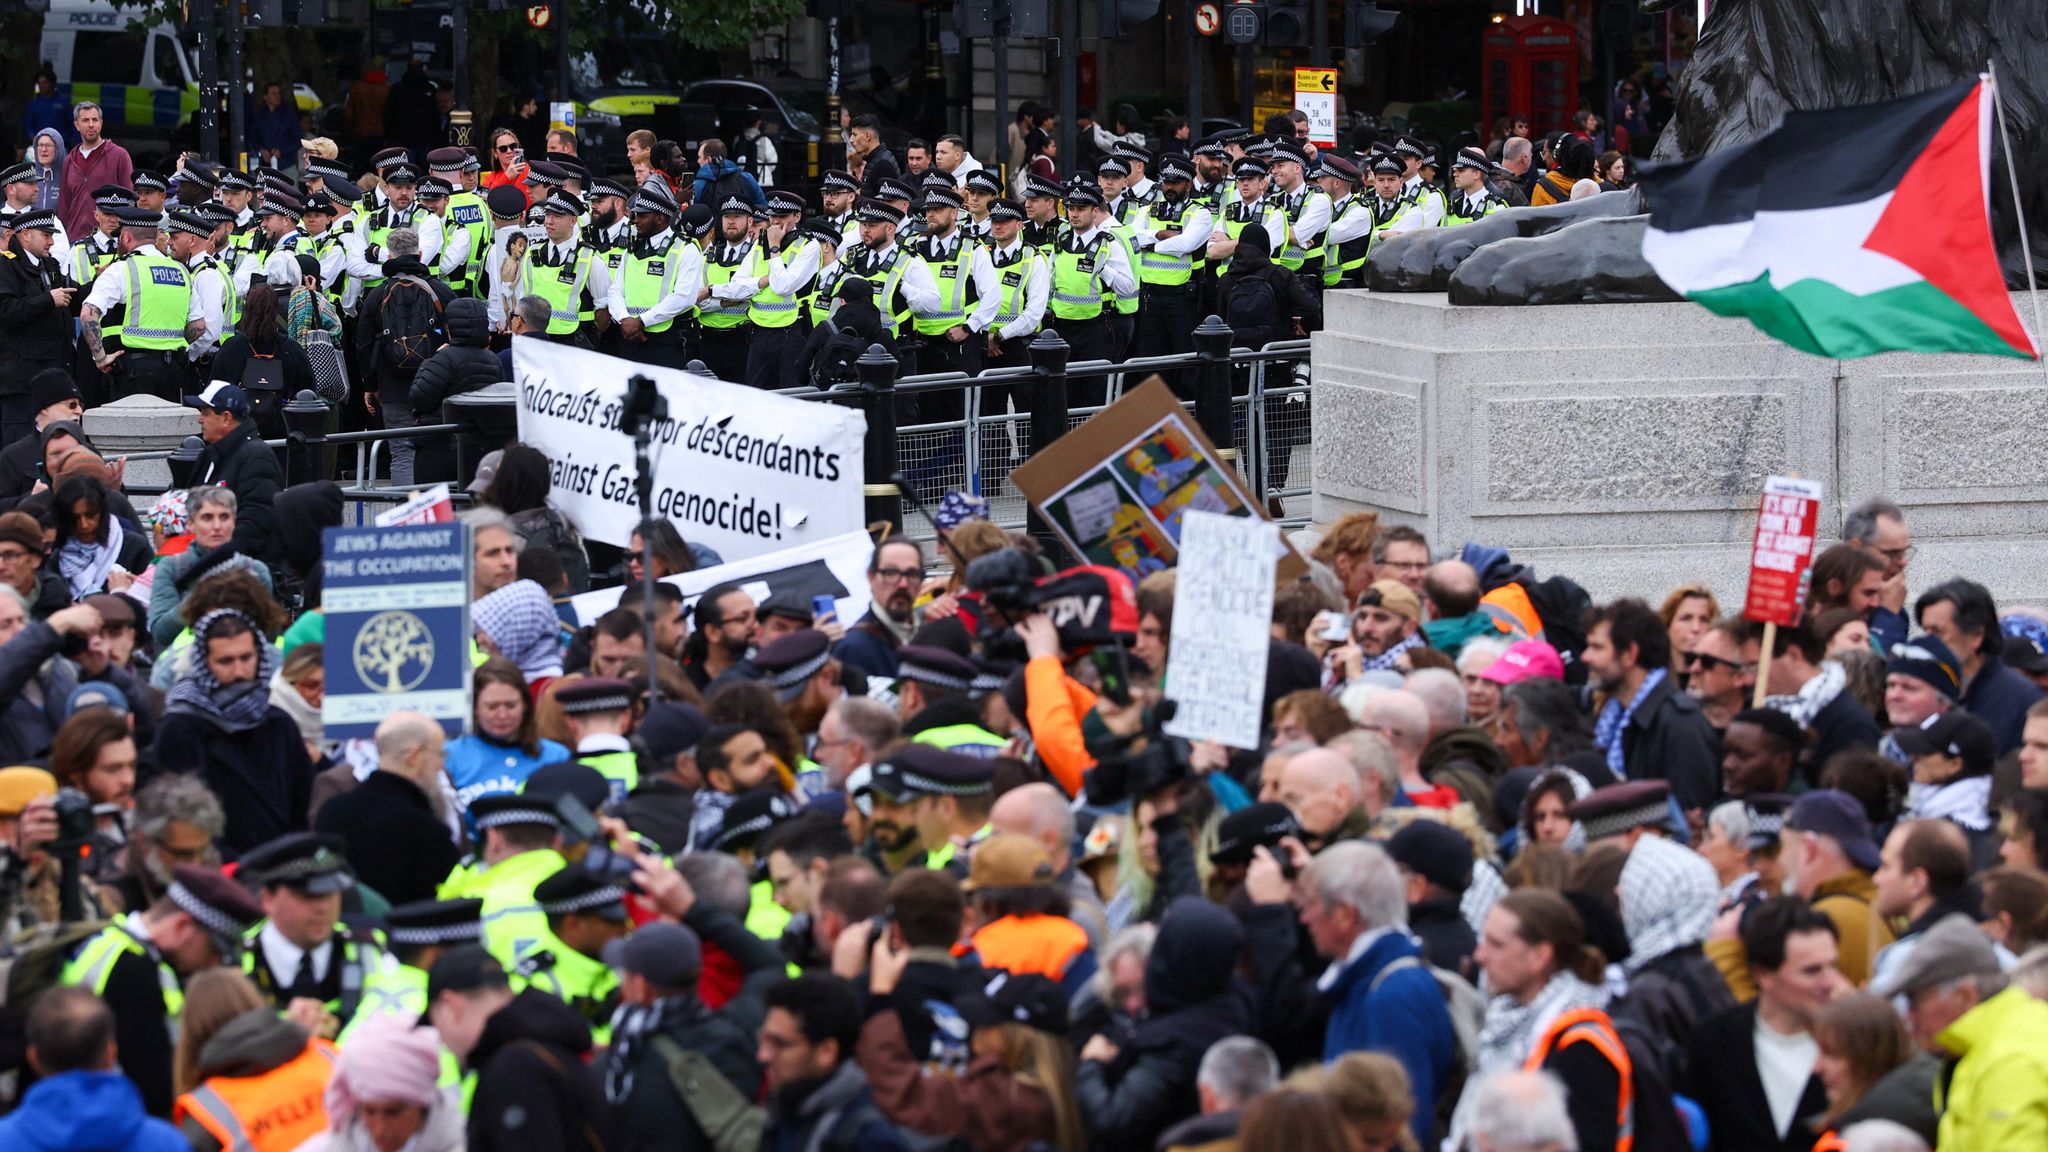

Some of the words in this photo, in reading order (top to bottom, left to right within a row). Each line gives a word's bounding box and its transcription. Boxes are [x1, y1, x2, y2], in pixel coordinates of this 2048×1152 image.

[69, 12, 118, 26] POLICE
[1297, 81, 1319, 89] Diversion
[1303, 100, 1310, 108] 14
[1321, 101, 1328, 109] 19
[1311, 110, 1320, 118] 38
[1318, 119, 1332, 127] N38
[454, 207, 482, 222] POLICE
[152, 268, 185, 283] POLICE
[600, 402, 687, 446] suvor
[687, 415, 840, 482] descendants
[549, 452, 599, 496] ainst
[601, 463, 640, 506] Gaz
[658, 487, 782, 541] genocide!
[334, 533, 378, 553] JEWS
[380, 529, 452, 550] AGAINST
[325, 559, 355, 577] THE
[357, 553, 464, 576] OCCUPATION
[250, 1093, 321, 1138] WELF
